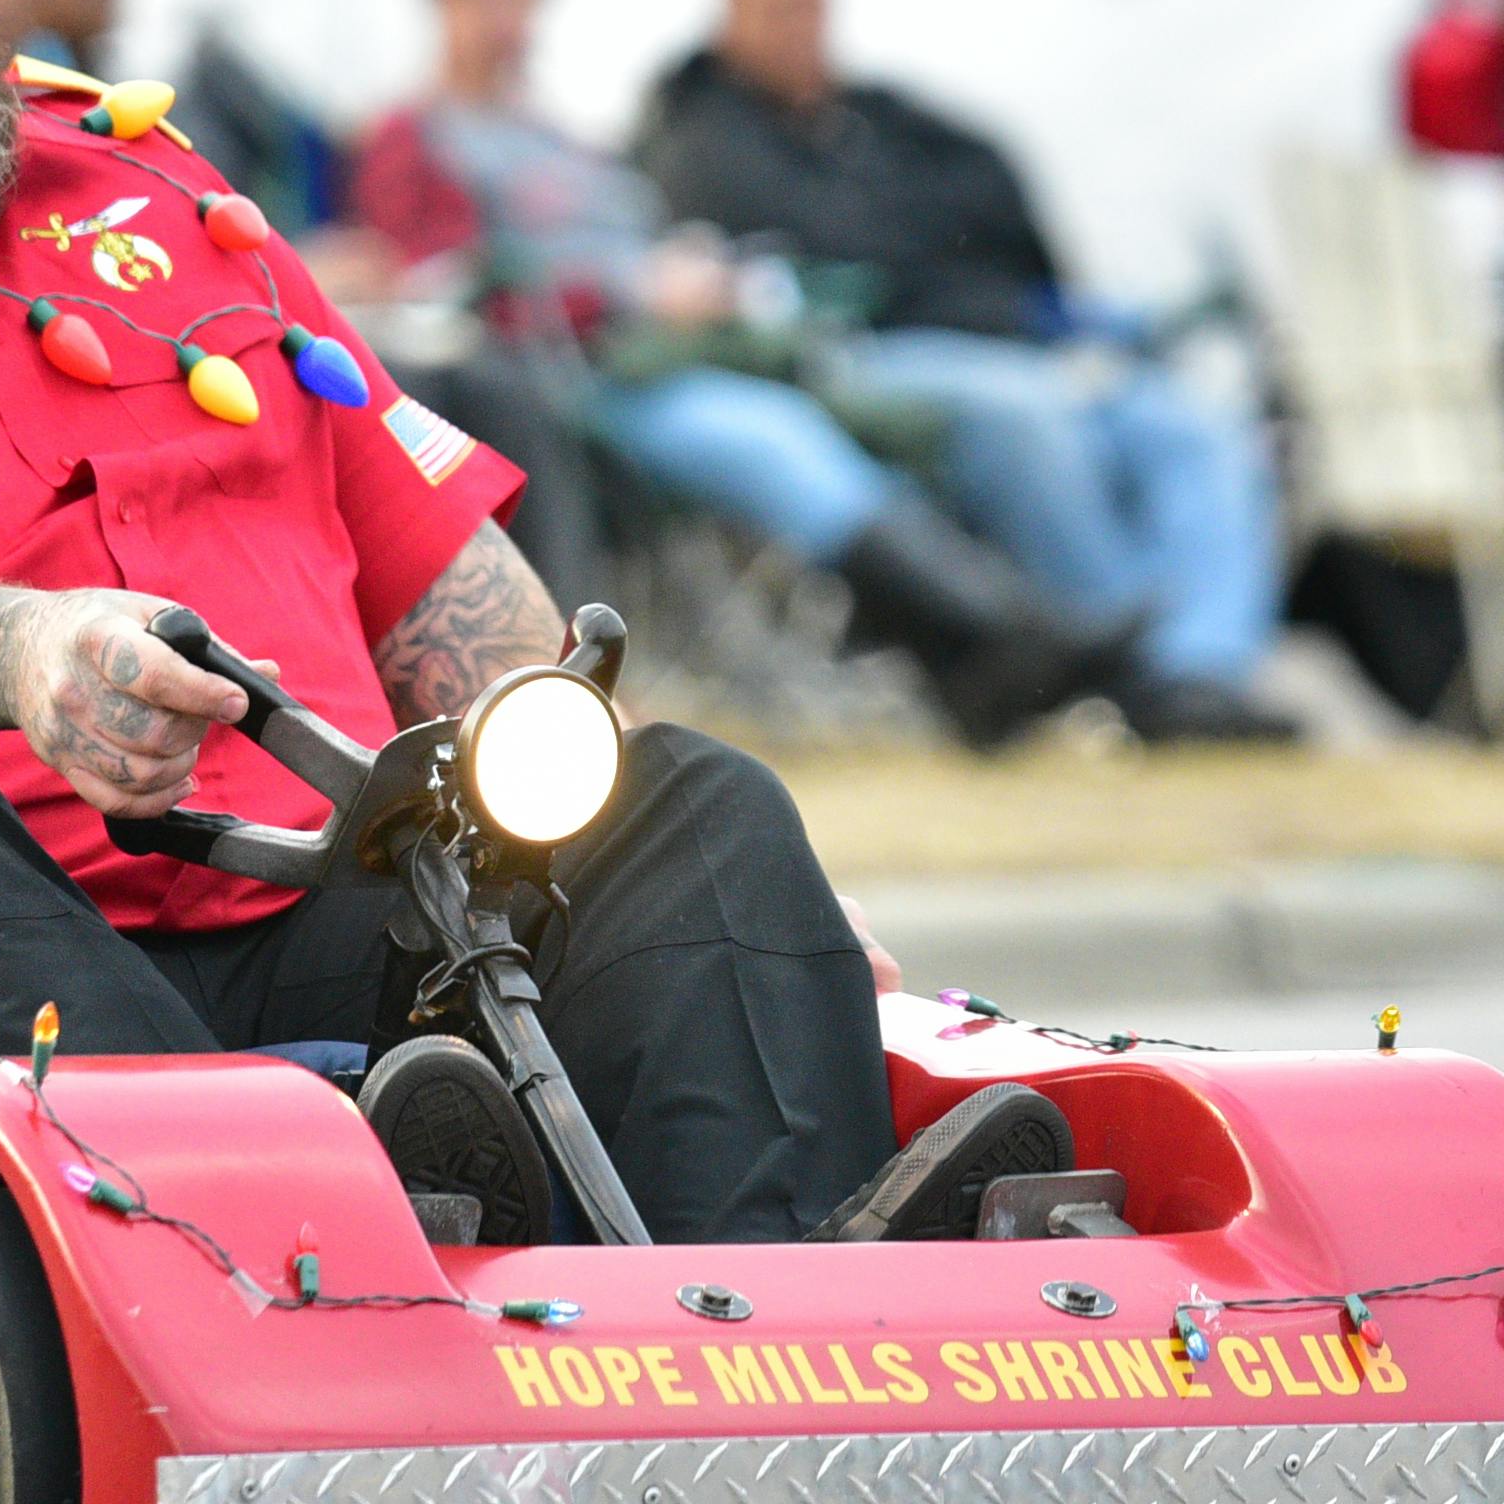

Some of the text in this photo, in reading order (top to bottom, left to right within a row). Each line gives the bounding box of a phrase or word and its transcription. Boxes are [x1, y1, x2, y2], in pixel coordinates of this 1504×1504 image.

[495, 1333, 1408, 1408] HOPE MILLS SHRINE CLUB
